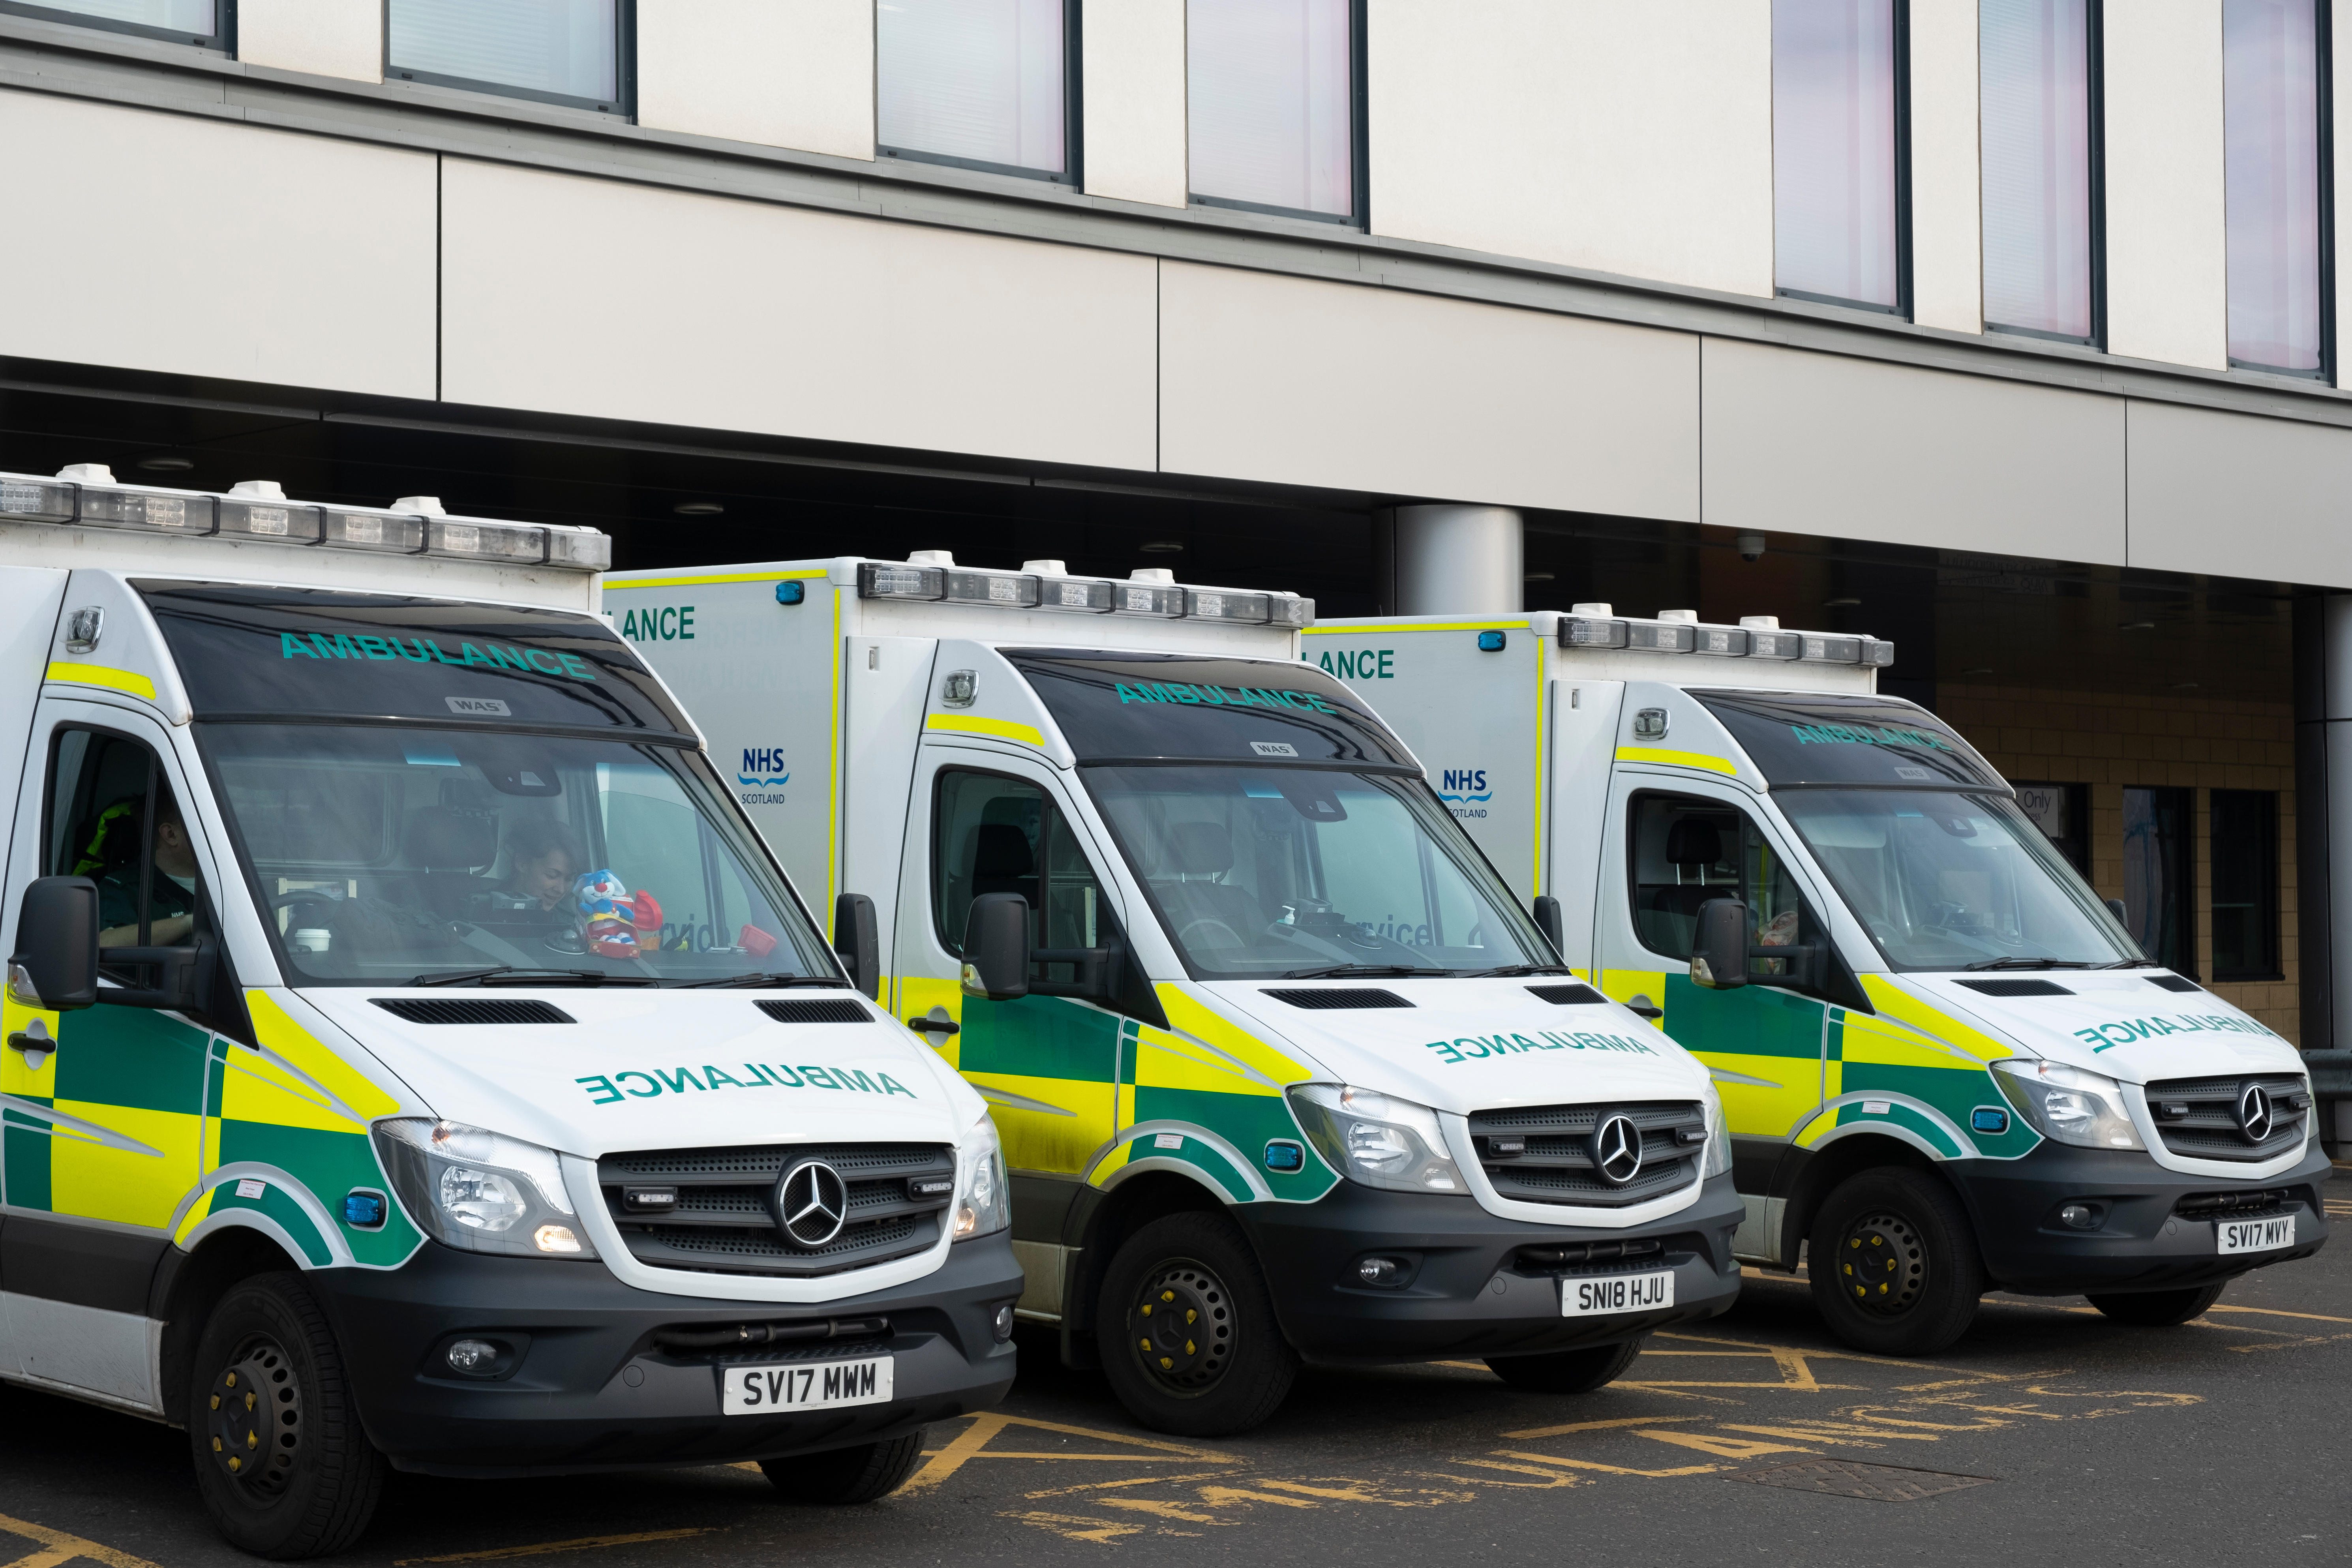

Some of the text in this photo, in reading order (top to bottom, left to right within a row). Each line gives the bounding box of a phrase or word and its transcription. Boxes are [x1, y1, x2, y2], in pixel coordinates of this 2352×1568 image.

[602, 606, 695, 641] ANCE
[280, 632, 596, 680] AMBULANCE
[1114, 683, 1337, 715] AMBULANCE
[1791, 725, 1953, 751] AMBULANCE
[743, 748, 784, 773] NHS
[1443, 769, 1487, 791] NHS
[741, 793, 785, 804] SCOTLAND
[2024, 790, 2051, 814] Only
[1449, 808, 1487, 818] OTLAND
[2228, 1219, 2288, 1248] SV17 MVY
[1579, 1277, 1664, 1310] SN18 HJU
[743, 1363, 876, 1405] SV17 MWM
